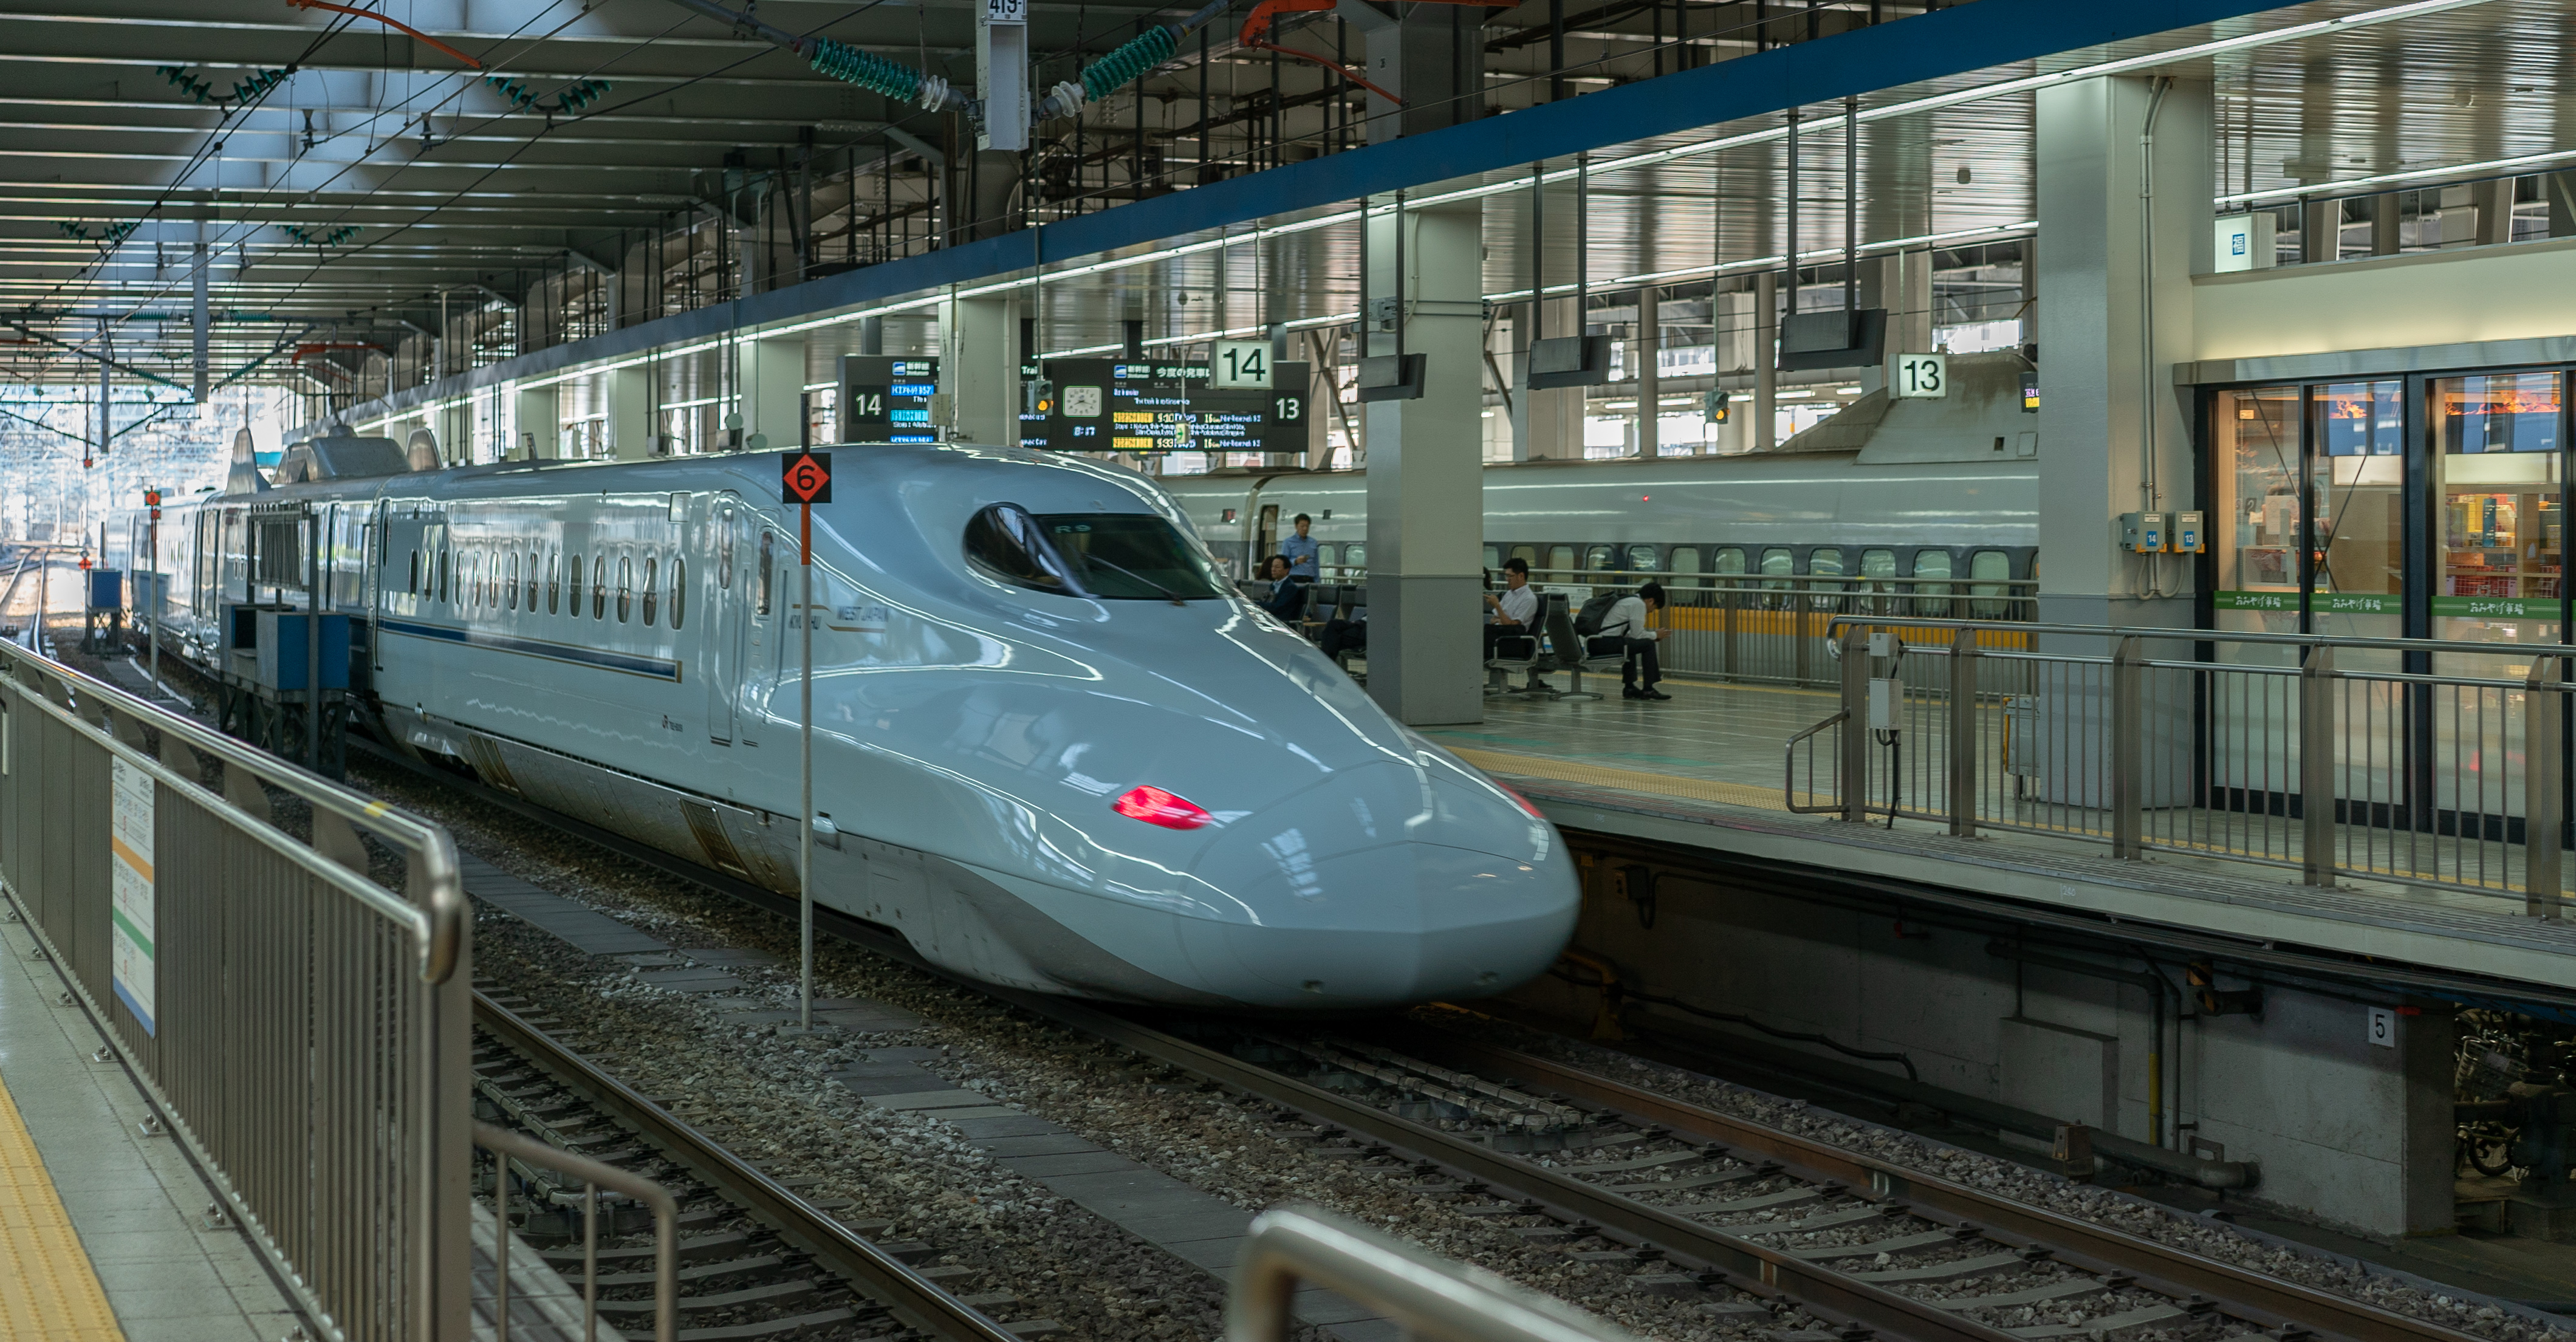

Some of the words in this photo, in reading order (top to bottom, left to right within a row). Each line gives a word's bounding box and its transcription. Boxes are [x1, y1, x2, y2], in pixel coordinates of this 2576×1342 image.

[2233, 235, 2244, 253] 福
[1021, 366, 1038, 375] Trai
[1223, 348, 1266, 382] 14
[1904, 360, 1940, 392] 13
[856, 394, 882, 416] 14
[1276, 398, 1299, 419] 13
[1074, 426, 1095, 436] 8:17
[797, 465, 815, 491] 6
[2148, 534, 2156, 543] 14
[2185, 534, 2194, 543] 13
[2376, 1013, 2385, 1039] 5
